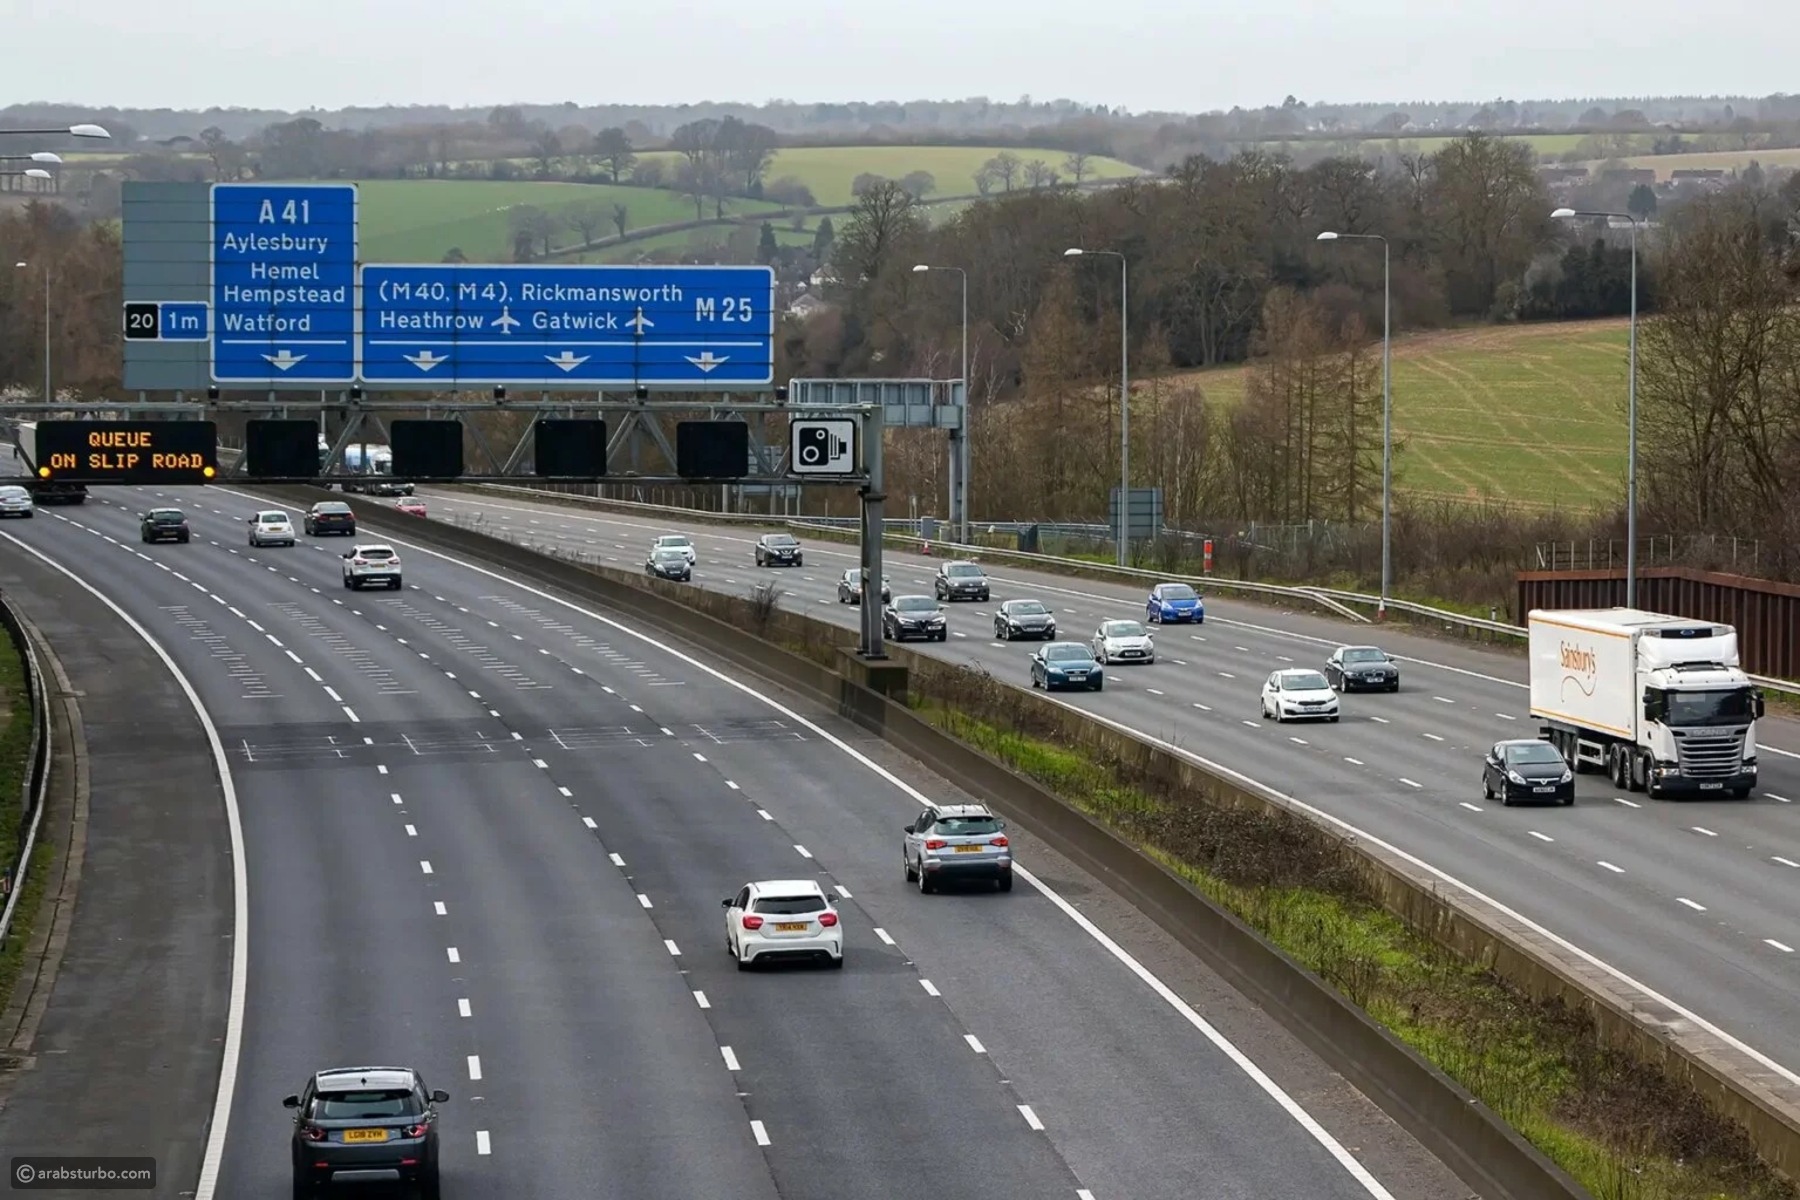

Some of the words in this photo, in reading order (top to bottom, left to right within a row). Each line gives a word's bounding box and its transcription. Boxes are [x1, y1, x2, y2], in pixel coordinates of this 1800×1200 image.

[223, 232, 328, 254] Aylesbury
[251, 262, 319, 279] Hemel
[224, 285, 345, 305] Hempstead
[522, 283, 683, 302] Rickmansworth
[130, 313, 154, 329] 20
[223, 313, 311, 332] Watford
[380, 311, 484, 329] Heathrow
[532, 311, 618, 329] Gatwick
[88, 432, 152, 447] QUEUE
[50, 454, 76, 469] ON
[89, 454, 139, 469] SLIP
[152, 454, 203, 469] ROAD
[1560, 640, 1596, 680] Sainsbury's
[1692, 729, 1728, 737] SCANIA
